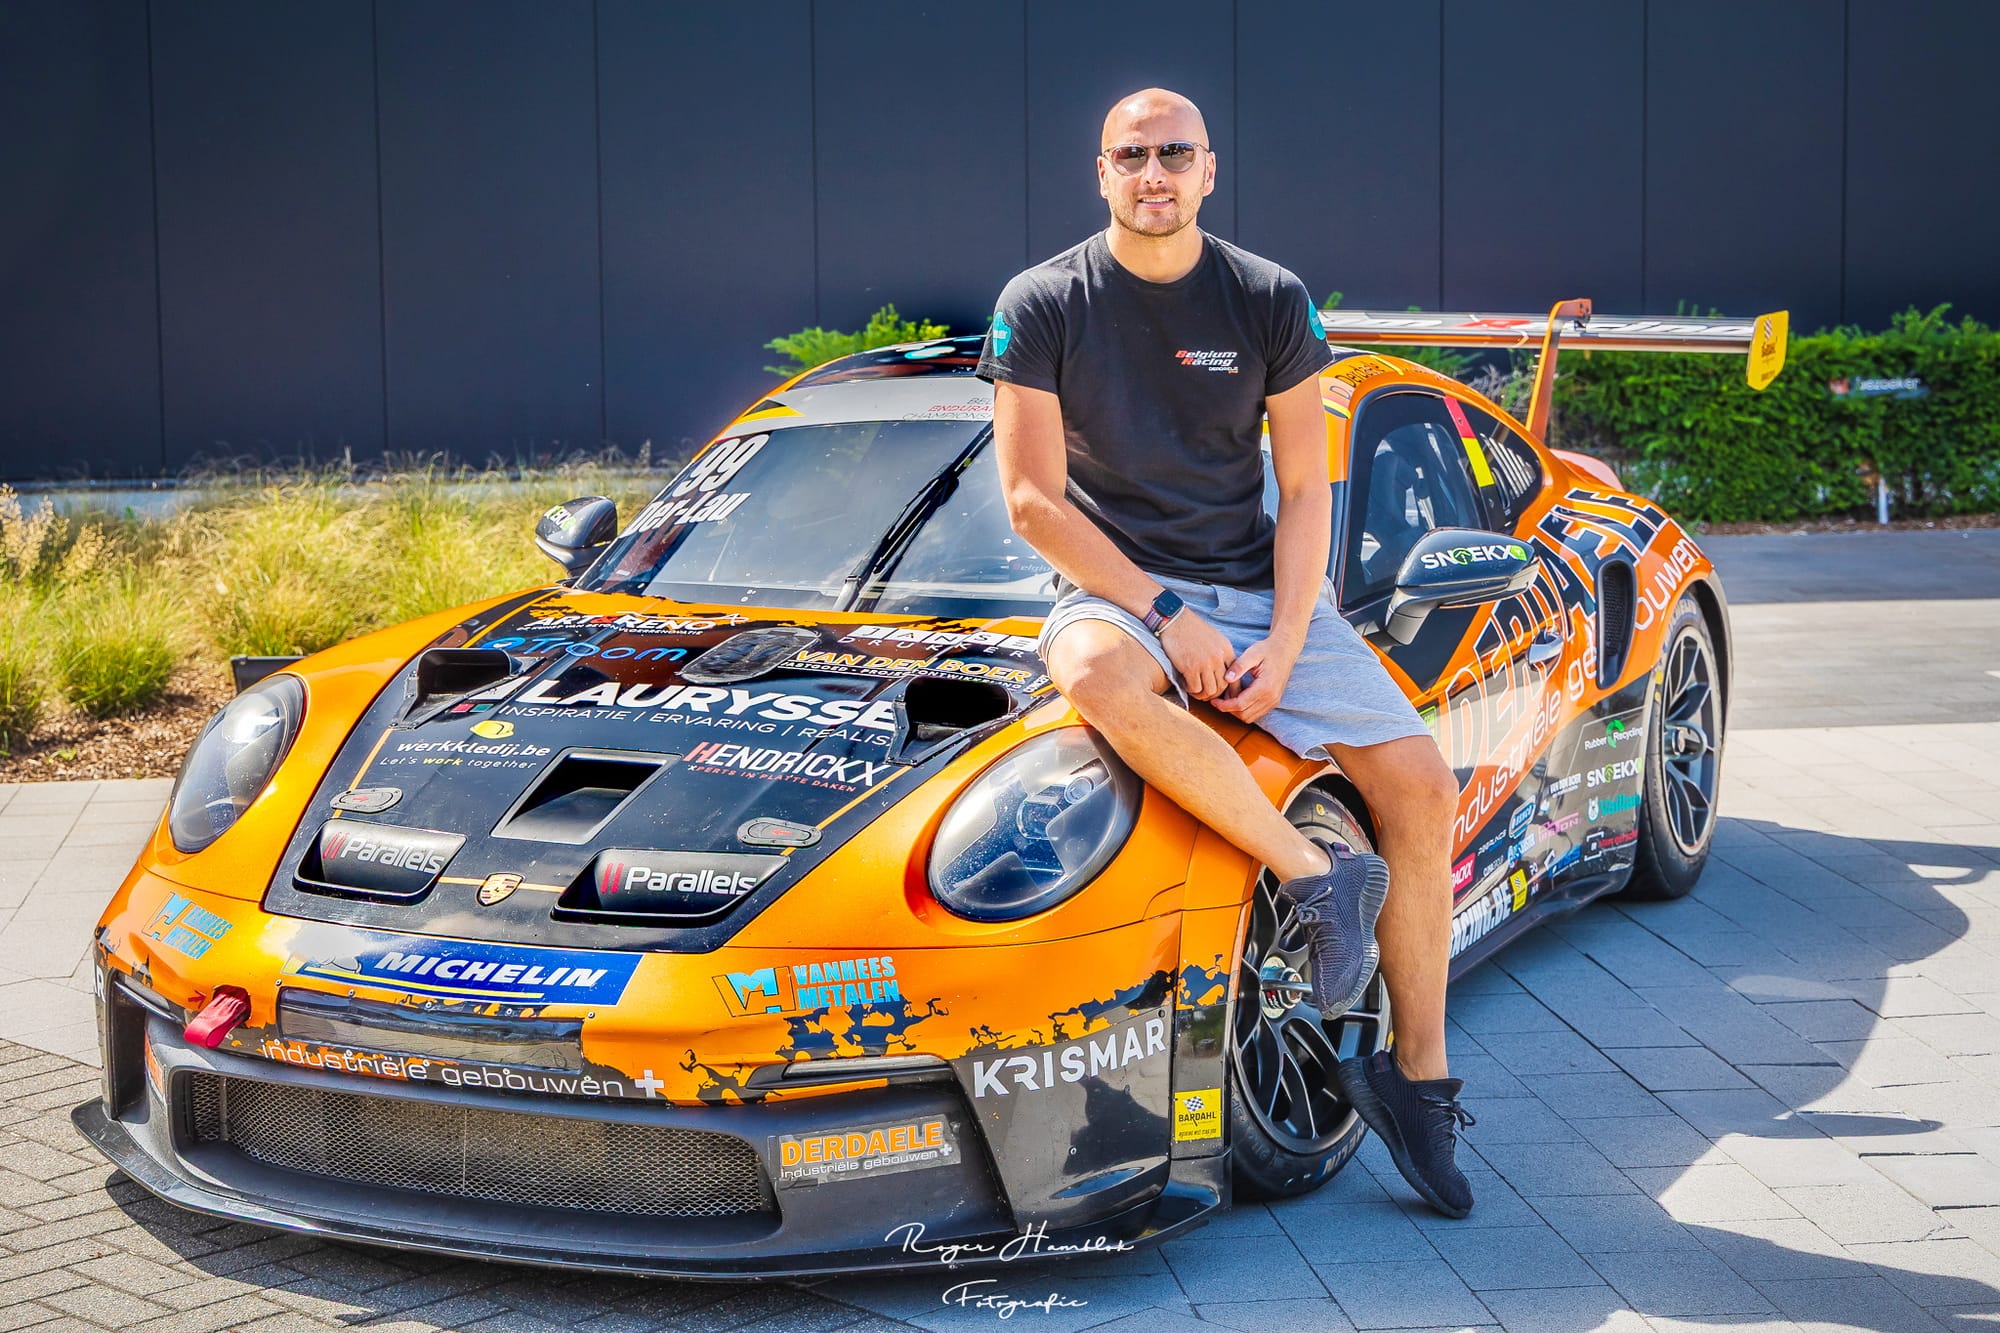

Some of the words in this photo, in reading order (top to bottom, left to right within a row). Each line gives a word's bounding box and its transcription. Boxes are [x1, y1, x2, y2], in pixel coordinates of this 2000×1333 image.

[1174, 350, 1238, 360] Belgium
[1181, 358, 1234, 367] Racing
[902, 412, 994, 421] CHAMPIONS
[966, 397, 994, 406] BEL
[672, 433, 771, 498] 99
[1421, 545, 1520, 570] SNOEKX
[795, 650, 866, 668] VAN
[866, 655, 938, 673] DEN
[940, 659, 1033, 684] BOER
[497, 704, 633, 722] INSPIRATIE
[649, 712, 777, 735] ERVARING
[379, 756, 418, 766] Let's
[422, 756, 464, 766] work
[467, 758, 537, 770] together
[397, 739, 551, 758] werkkledij.be
[682, 741, 891, 787] HENDRICKX
[687, 765, 737, 777] XPERTS
[740, 771, 755, 780] IN
[760, 772, 807, 785] PLATTE
[812, 779, 857, 792] DAKEN
[340, 836, 446, 875] Parallels
[624, 866, 758, 896] Parallels
[374, 951, 609, 987] MICHELIN
[793, 955, 897, 985] VANHEES
[796, 979, 901, 1010] METALEN
[260, 1037, 431, 1081] industriële
[441, 1066, 624, 1099] gebouwen
[972, 1018, 1167, 1099] KRISMAR
[1178, 1110, 1217, 1124] BARDAHL
[780, 1121, 943, 1167] DERDAELE
[781, 1159, 859, 1179] industriële
[863, 1149, 938, 1171] gebouwen
